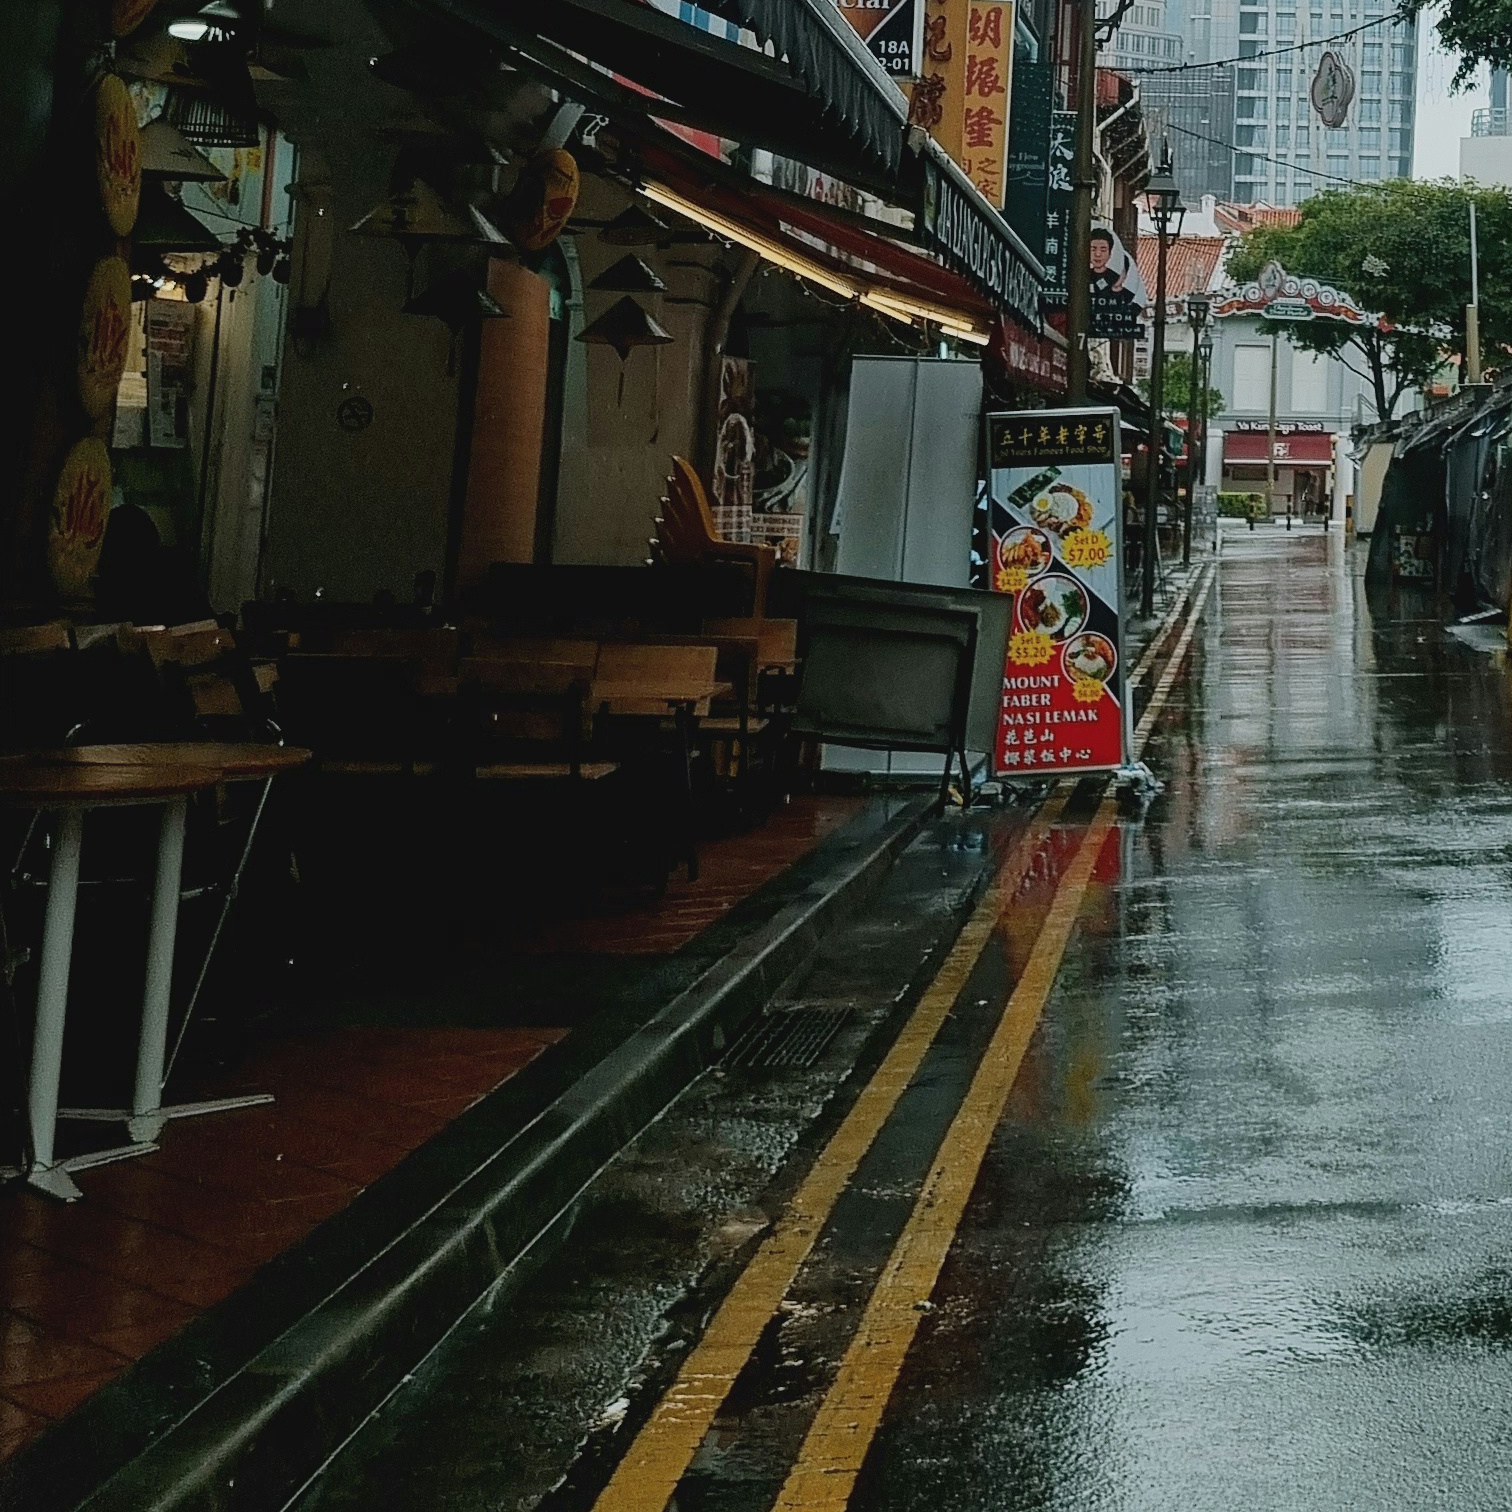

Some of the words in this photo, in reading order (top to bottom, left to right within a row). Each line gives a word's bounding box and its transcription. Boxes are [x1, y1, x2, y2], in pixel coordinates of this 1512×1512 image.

[878, 40, 910, 55] 18A
[1296, 421, 1323, 432] Toast
[1073, 534, 1090, 546] Set
[1091, 534, 1099, 545] D
[1068, 547, 1106, 563] $7.00
[1015, 646, 1047, 659] $5.20
[1003, 675, 1061, 689] MOUNT
[1003, 693, 1051, 708] FABER
[1003, 711, 1041, 726] NASI
[1045, 709, 1099, 724] LEMAK
